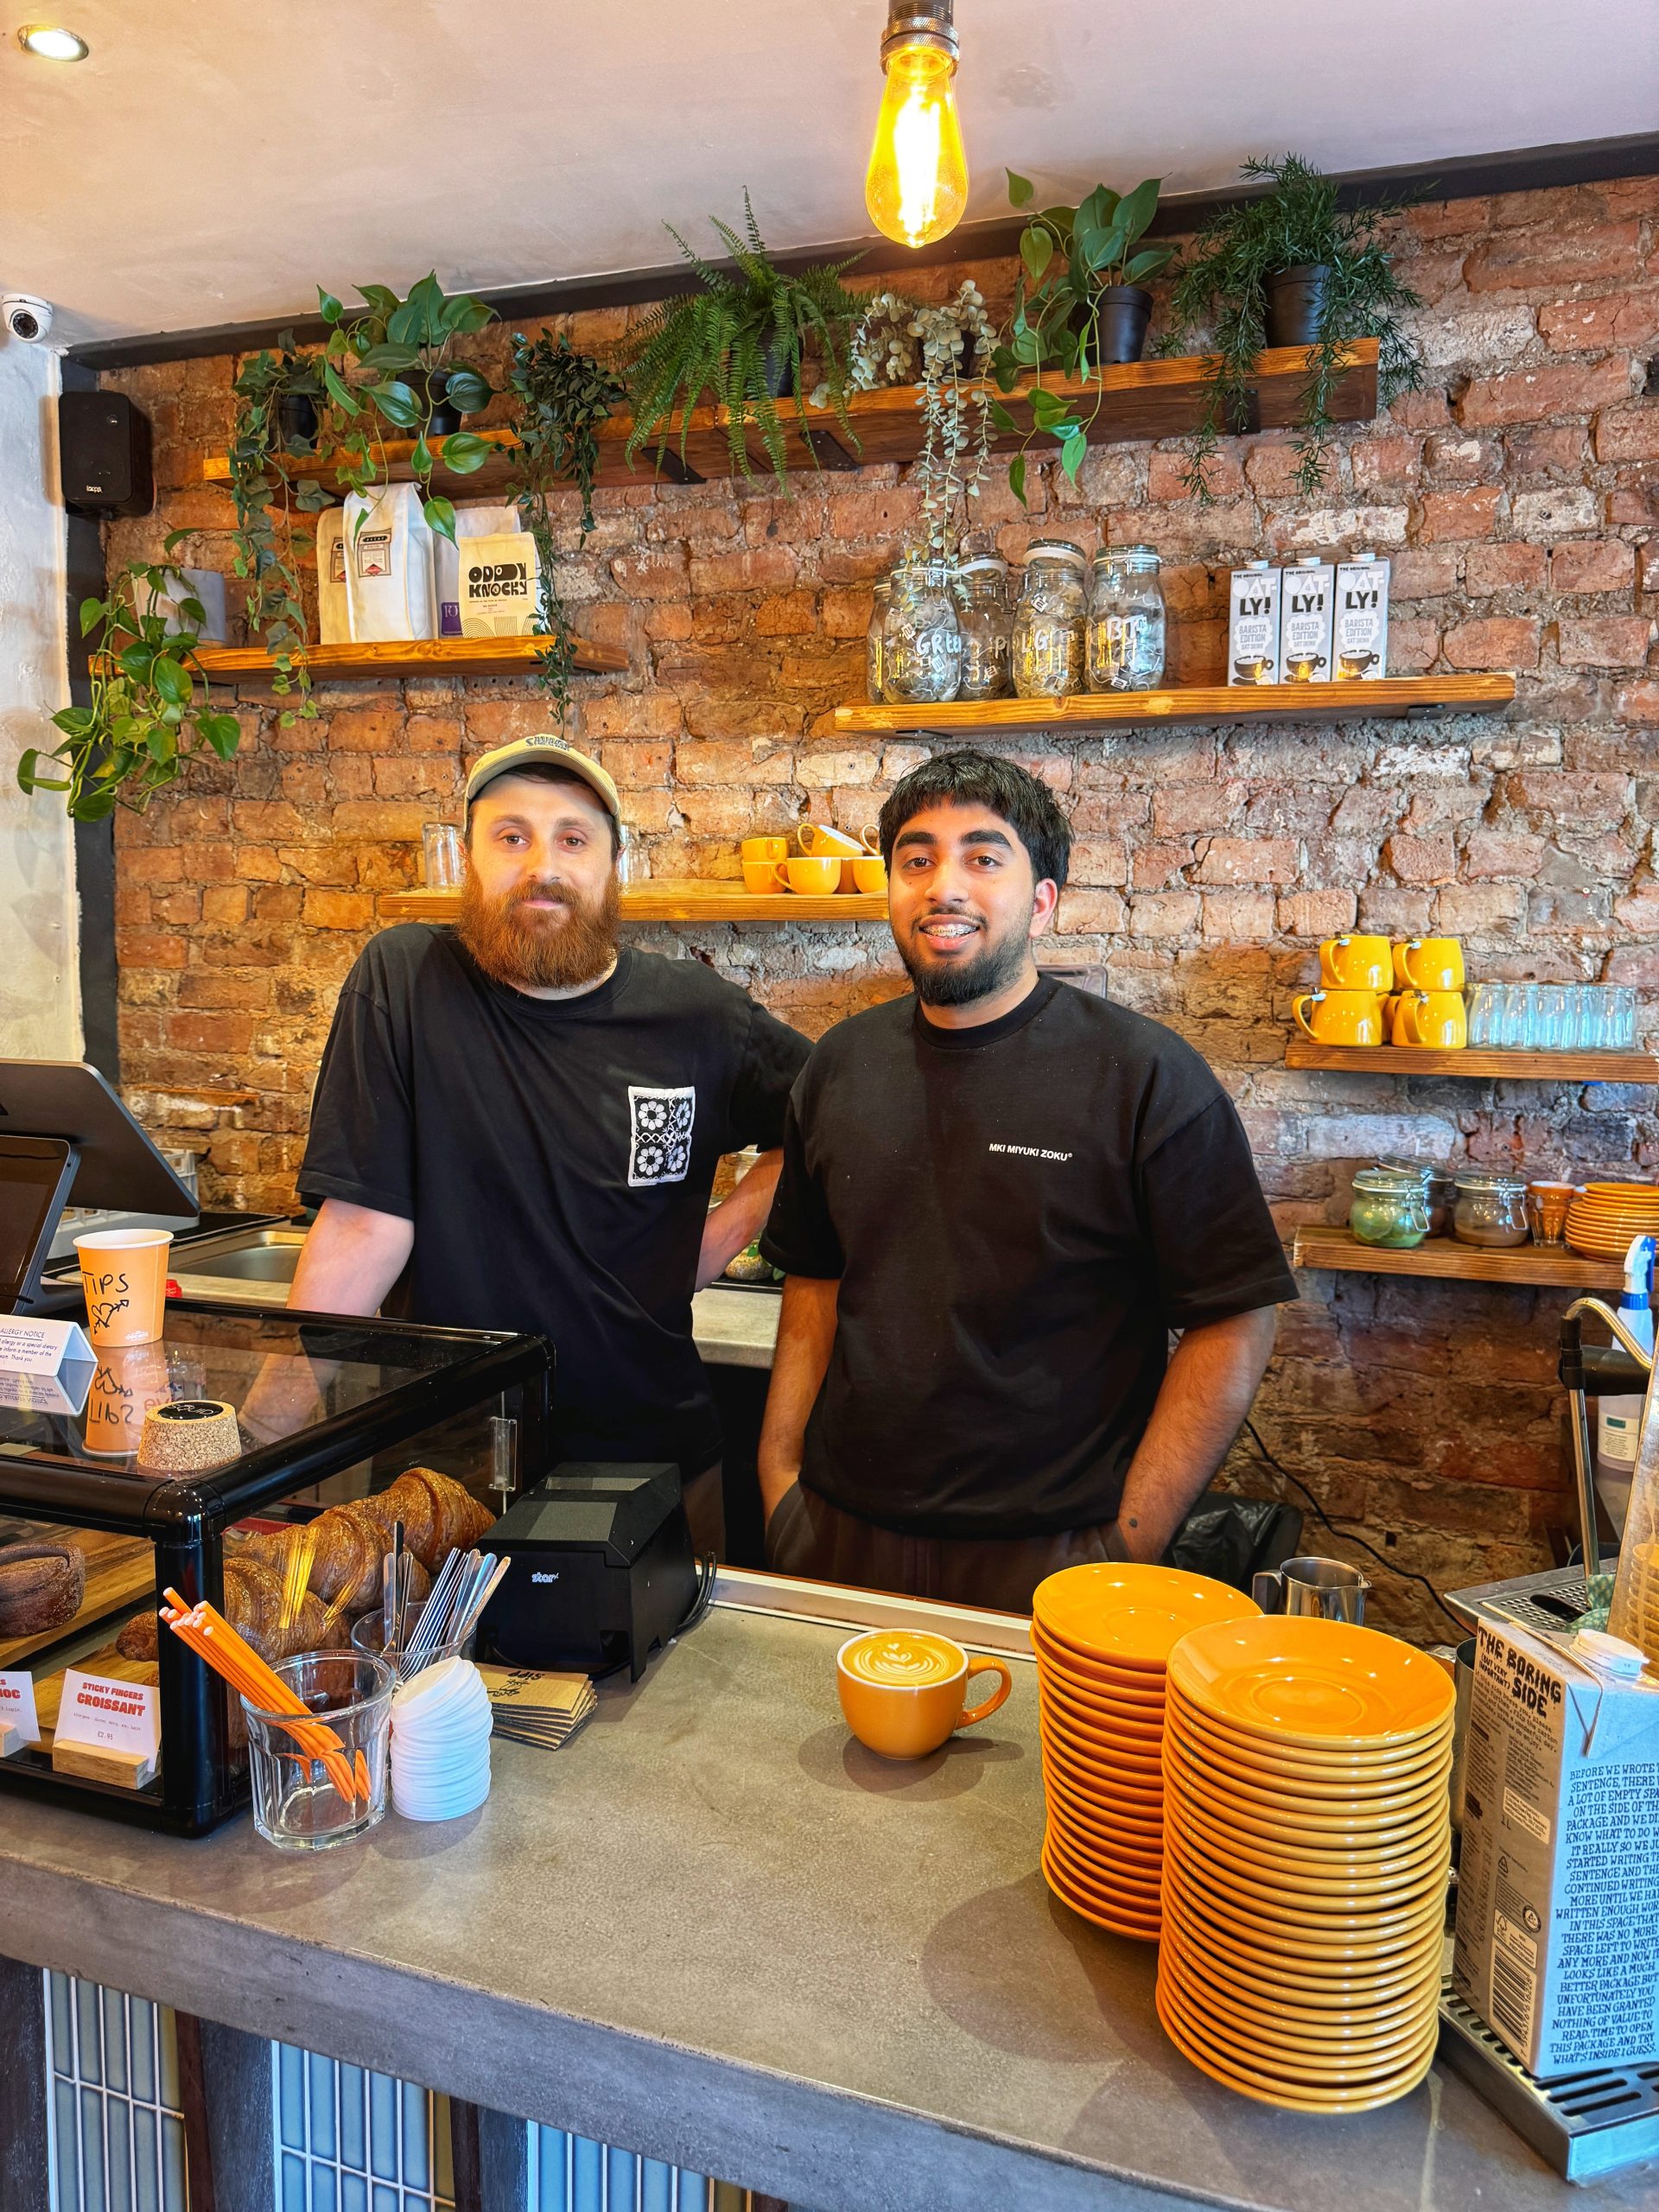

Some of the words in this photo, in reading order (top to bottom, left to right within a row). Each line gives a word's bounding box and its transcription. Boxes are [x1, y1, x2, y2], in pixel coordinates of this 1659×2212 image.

[468, 563, 527, 582] ODDY
[469, 581, 527, 598] KNOCKY
[1240, 597, 1271, 616] LY!
[1292, 594, 1324, 613] LY!
[1345, 590, 1378, 609] LY!
[1239, 625, 1267, 633] BARISTA
[1292, 621, 1319, 631] BARISTA
[1345, 618, 1373, 627] BARISTA
[1240, 634, 1265, 643] EDITION
[1293, 631, 1319, 640] EDITION
[1346, 627, 1372, 637] EDITION
[988, 1143, 1006, 1153] MKI
[1007, 1145, 1039, 1157] MIYUKI
[82, 1271, 130, 1295] TIPS
[1478, 1626, 1504, 1659] THE
[1507, 1647, 1561, 1704] BORING
[1481, 1653, 1493, 1668] (BUT
[1493, 1664, 1507, 1677] VERY
[82, 1681, 110, 1695] STICKY
[111, 1688, 143, 1700] FINGERS
[1512, 1677, 1547, 1719] SIDE
[77, 1692, 145, 1717] CROISSANT
[98, 1731, 113, 1740] £2.95
[1570, 1766, 1604, 1780] BEFORE
[1606, 1764, 1620, 1776] WE
[1623, 1764, 1656, 1774] WROTE
[1571, 1777, 1620, 1793] SENTENCE,
[1622, 1776, 1655, 1787] THERE
[1567, 1796, 1574, 1806] A
[1576, 1792, 1593, 1805] LOT
[1594, 1790, 1606, 1802] OF
[1608, 1789, 1642, 1802] EMPTY
[1573, 1806, 1586, 1818] ON
[1588, 1803, 1606, 1815] THE
[1609, 1801, 1630, 1815] SIDE
[1631, 1801, 1645, 1812] OF
[1567, 1816, 1608, 1831] PACKAGE
[1610, 1815, 1630, 1827] AND
[1632, 1815, 1647, 1825] WE
[1566, 1830, 1593, 1844] KNOW
[1595, 1828, 1623, 1840] WHAT
[1624, 1827, 1636, 1839] TO
[1637, 1827, 1649, 1838] DO
[1571, 1846, 1581, 1856] IT
[1582, 1841, 1619, 1855] REALLY
[1620, 1840, 1631, 1853] SO
[1634, 1840, 1649, 1851] WE
[1567, 1855, 1608, 1869] STARTED
[1611, 1853, 1649, 1865] WRITING
[1570, 1867, 1620, 1882] SENTENCE
[1622, 1866, 1641, 1878] AND
[1565, 1881, 1619, 1894] CONTINUED
[1621, 1877, 1659, 1890] WRITING
[1570, 1894, 1598, 1907] MORE
[1599, 1891, 1628, 1904] UNTIL
[1630, 1891, 1643, 1902] WE
[1555, 1906, 1599, 1919] WRITTEN
[1601, 1904, 1639, 1916] ENOUGH
[1569, 1920, 1580, 1931] IN
[1583, 1918, 1605, 1930] THIS
[1606, 1915, 1636, 1929] SPACE
[1636, 1913, 1659, 1925] THAT
[1561, 1932, 1595, 1943] THERE
[1595, 1929, 1616, 1942] WAS
[1617, 1929, 1630, 1940] NO
[1633, 1924, 1658, 1937] MORE
[1562, 1943, 1593, 1956] SPACE
[1595, 1941, 1619, 1955] LEFT
[1620, 1940, 1631, 1952] TO
[1633, 1936, 1659, 1950] WRITE
[1556, 1957, 1579, 1968] ANY
[1581, 1955, 1608, 1967] MORE
[1610, 1953, 1630, 1965] AND
[1631, 1950, 1651, 1963] NOW
[1564, 1967, 1596, 1980] LOOKS
[1597, 1966, 1619, 1979] LIKE
[1619, 1967, 1627, 1975] A
[1629, 1961, 1656, 1974] MUCH
[1560, 1980, 1598, 1993] BETTER
[1599, 1975, 1640, 1991] PACKAGE
[1642, 1972, 1659, 1985] BUT
[1557, 1988, 1637, 2005] UNFORTUNATELY
[1637, 1985, 1656, 1996] YOU
[1558, 2006, 1585, 2017] HAVE
[1586, 2004, 1611, 2014] BEEN
[1612, 1996, 1656, 2012] GRANTED
[1552, 2017, 1596, 2030] NOTHING
[1597, 2015, 1610, 2025] OF
[1611, 2012, 1641, 2024] VALUE
[1641, 2009, 1653, 2019] TO
[1561, 2030, 1590, 2041] READ.
[1590, 2027, 1615, 2037] TIME
[1616, 2024, 1628, 2036] TO
[1629, 2021, 1654, 2033] OPEN
[1549, 2042, 1573, 2053] THIS
[1573, 2037, 1616, 2051] PACKAGE
[1617, 2035, 1637, 2046] AND
[1637, 2032, 1655, 2044] TRY
[1553, 2051, 1588, 2064] WHAT'S
[1588, 2048, 1620, 2061] INSIDE
[1621, 2047, 1625, 2056] I
[1625, 2042, 1656, 2056] GUESS.
